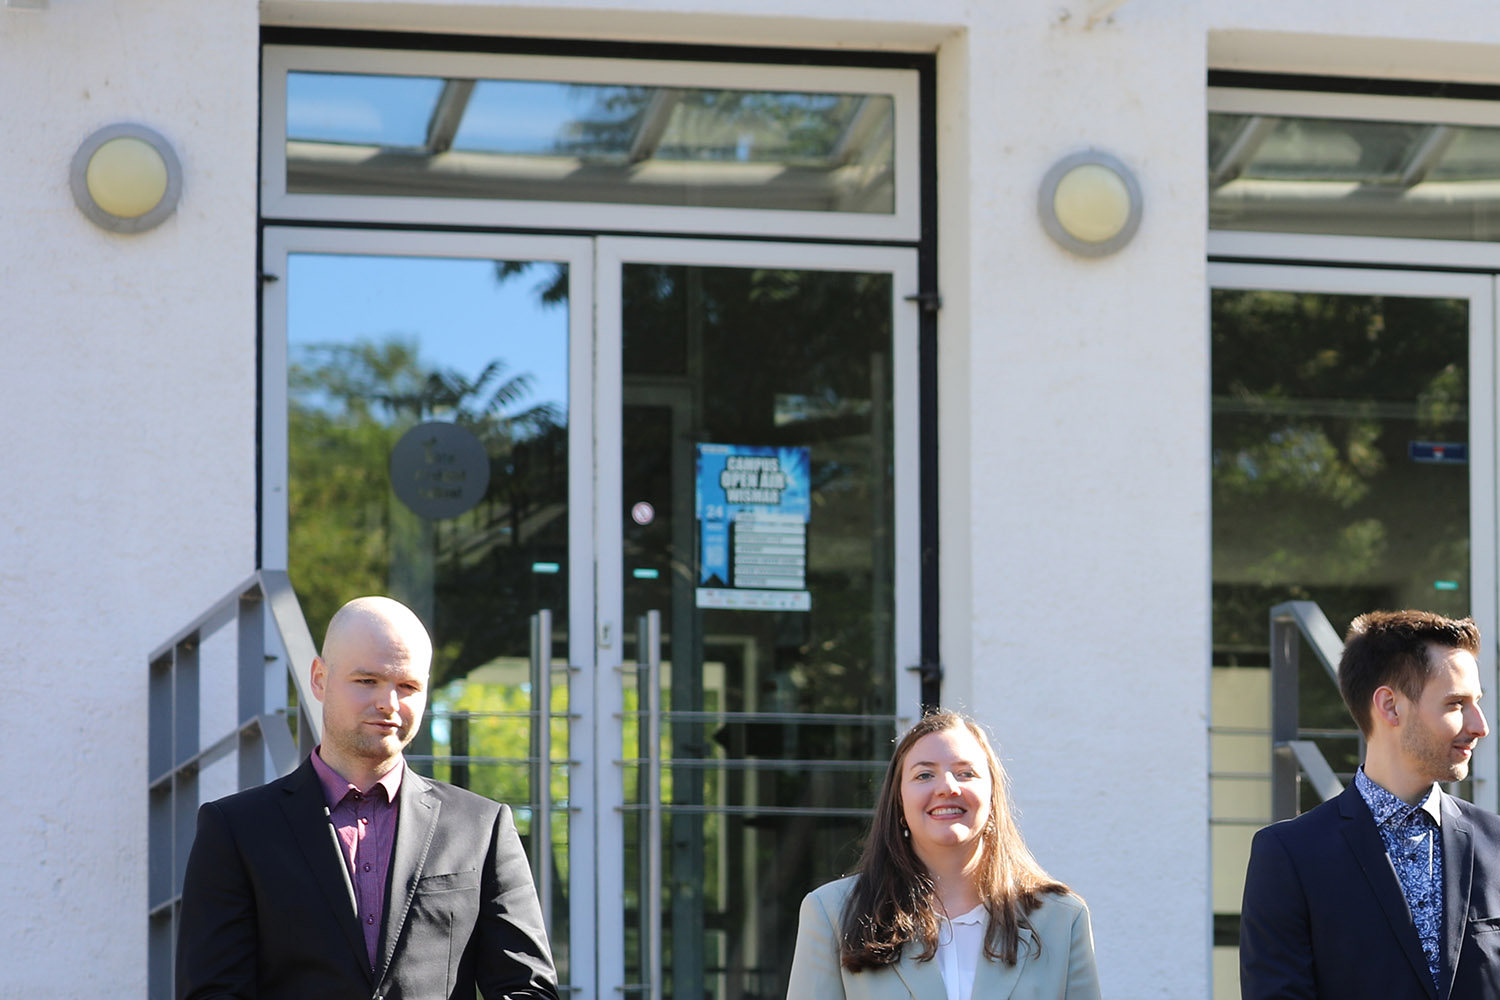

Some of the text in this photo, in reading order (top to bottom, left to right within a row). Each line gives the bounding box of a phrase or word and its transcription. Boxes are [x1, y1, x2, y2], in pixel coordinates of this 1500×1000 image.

[727, 456, 779, 472] CAMPUS
[721, 470, 786, 489] OPEN AIR
[727, 488, 780, 504] WISMAR
[706, 504, 724, 519] 24
